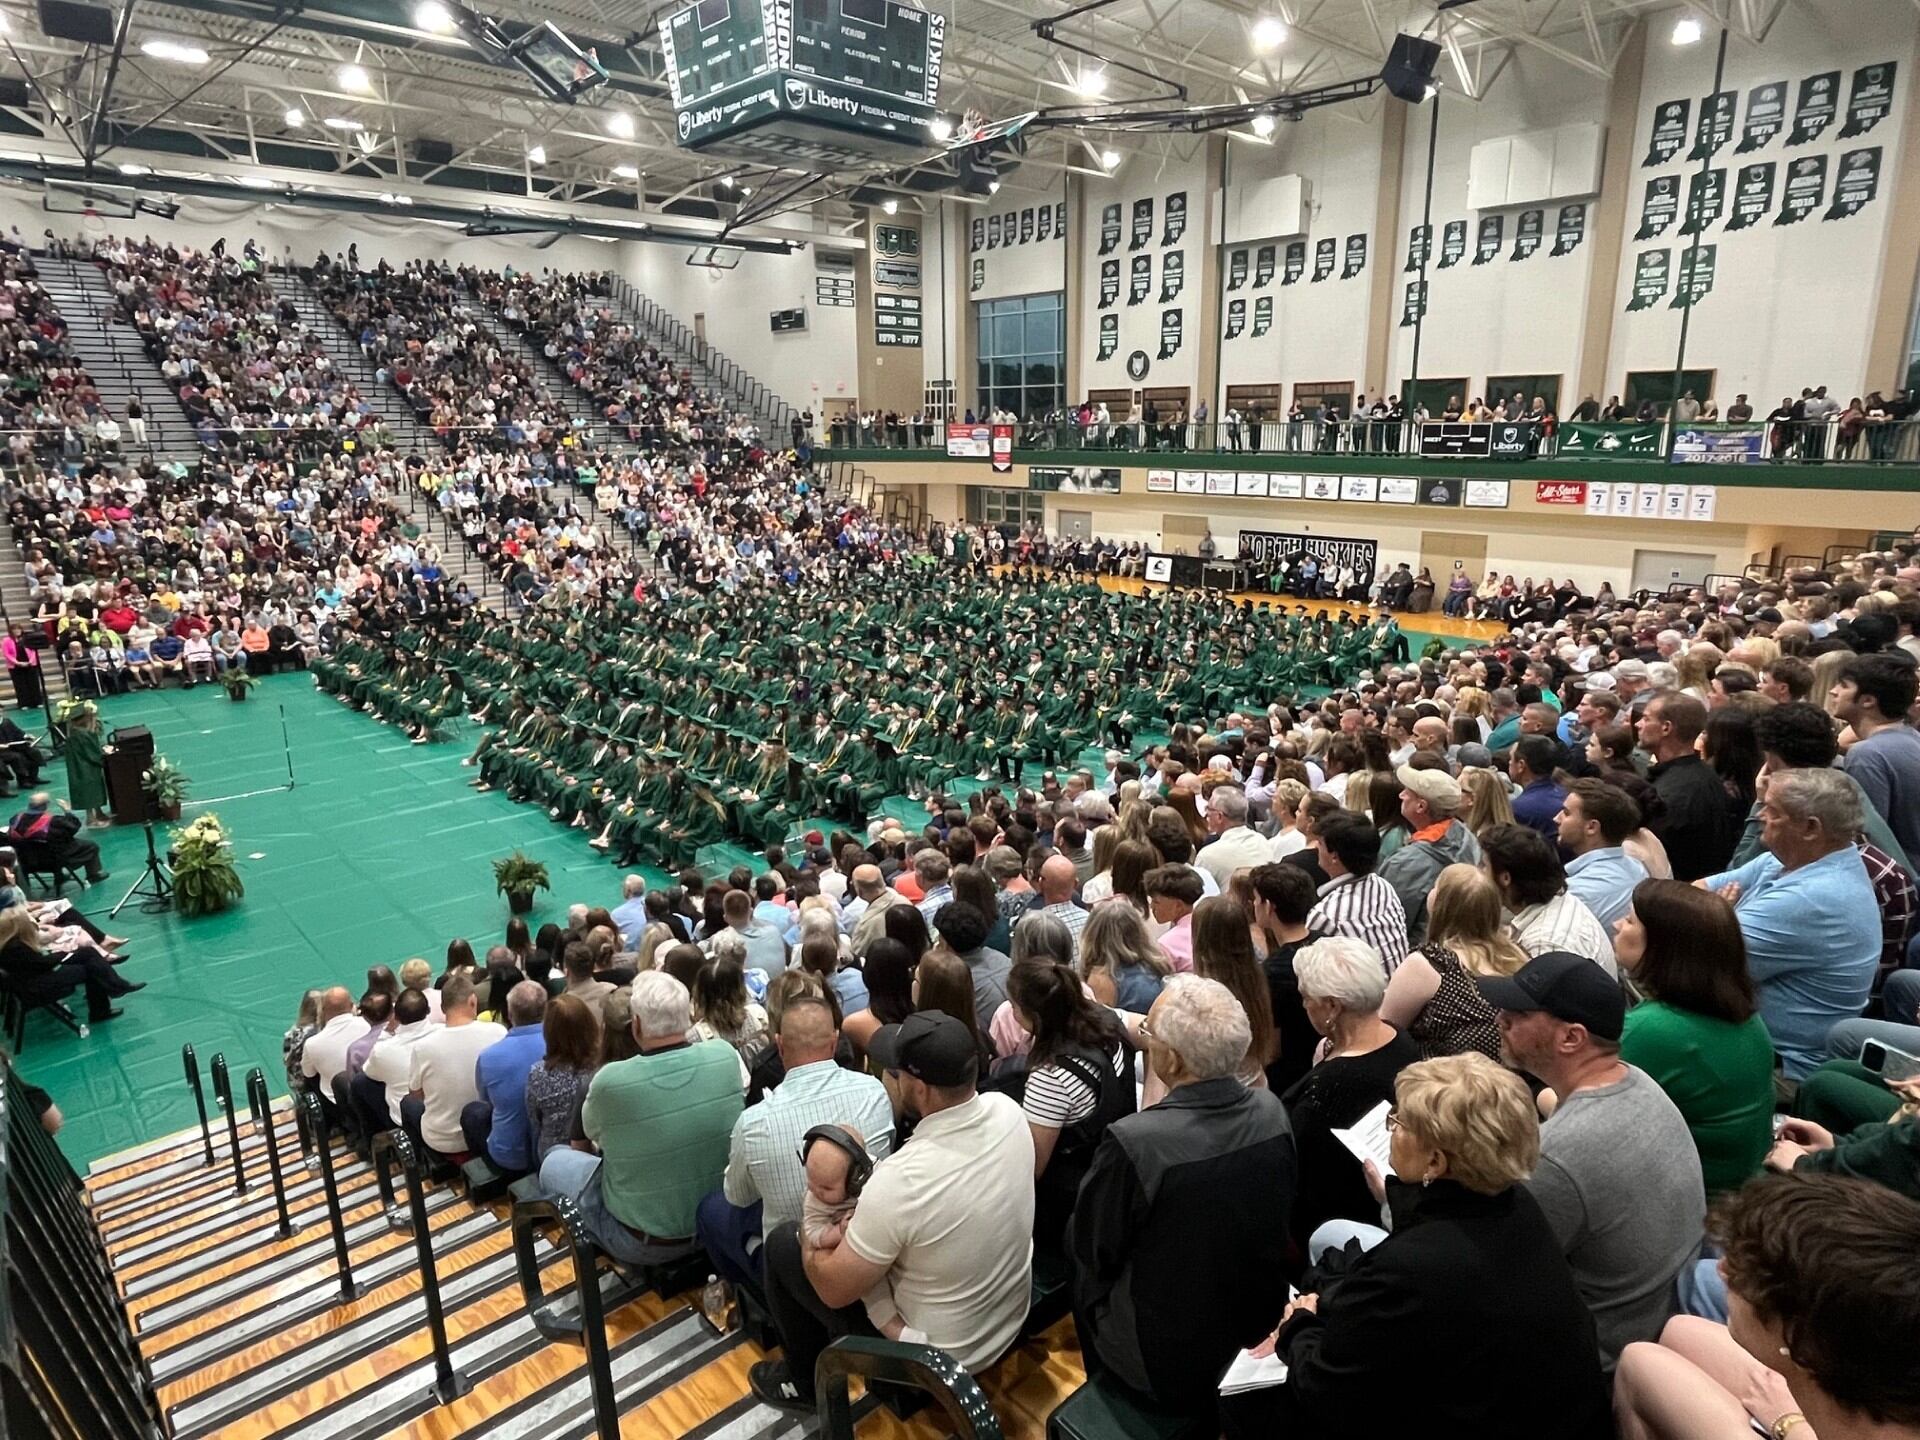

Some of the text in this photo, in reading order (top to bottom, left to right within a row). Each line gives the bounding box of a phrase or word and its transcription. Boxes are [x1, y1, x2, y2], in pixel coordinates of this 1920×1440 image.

[898, 7, 923, 23] HOME
[776, 0, 791, 69] NOR
[841, 26, 867, 40] PERIOD
[926, 13, 945, 104] HUSKIES
[808, 88, 859, 116] Liberty
[861, 104, 888, 118] FEDERAL
[889, 111, 910, 123] CREDIT
[692, 106, 722, 128] Liberty
[1802, 115, 1829, 128] 1977
[1702, 131, 1725, 144] 173
[1171, 229, 1179, 239] N
[1683, 284, 1706, 293] 224
[902, 335, 919, 344] 1977
[1493, 442, 1525, 451] Liberty
[1684, 453, 1747, 463] 2017-2018
[1596, 494, 1602, 505] 7
[1620, 496, 1627, 506] 5
[1646, 497, 1652, 507] 7
[1671, 498, 1678, 508] 5
[1699, 499, 1706, 509] 7
[1240, 534, 1374, 573] NORTH HUSKIES
[781, 1382, 799, 1399] N
